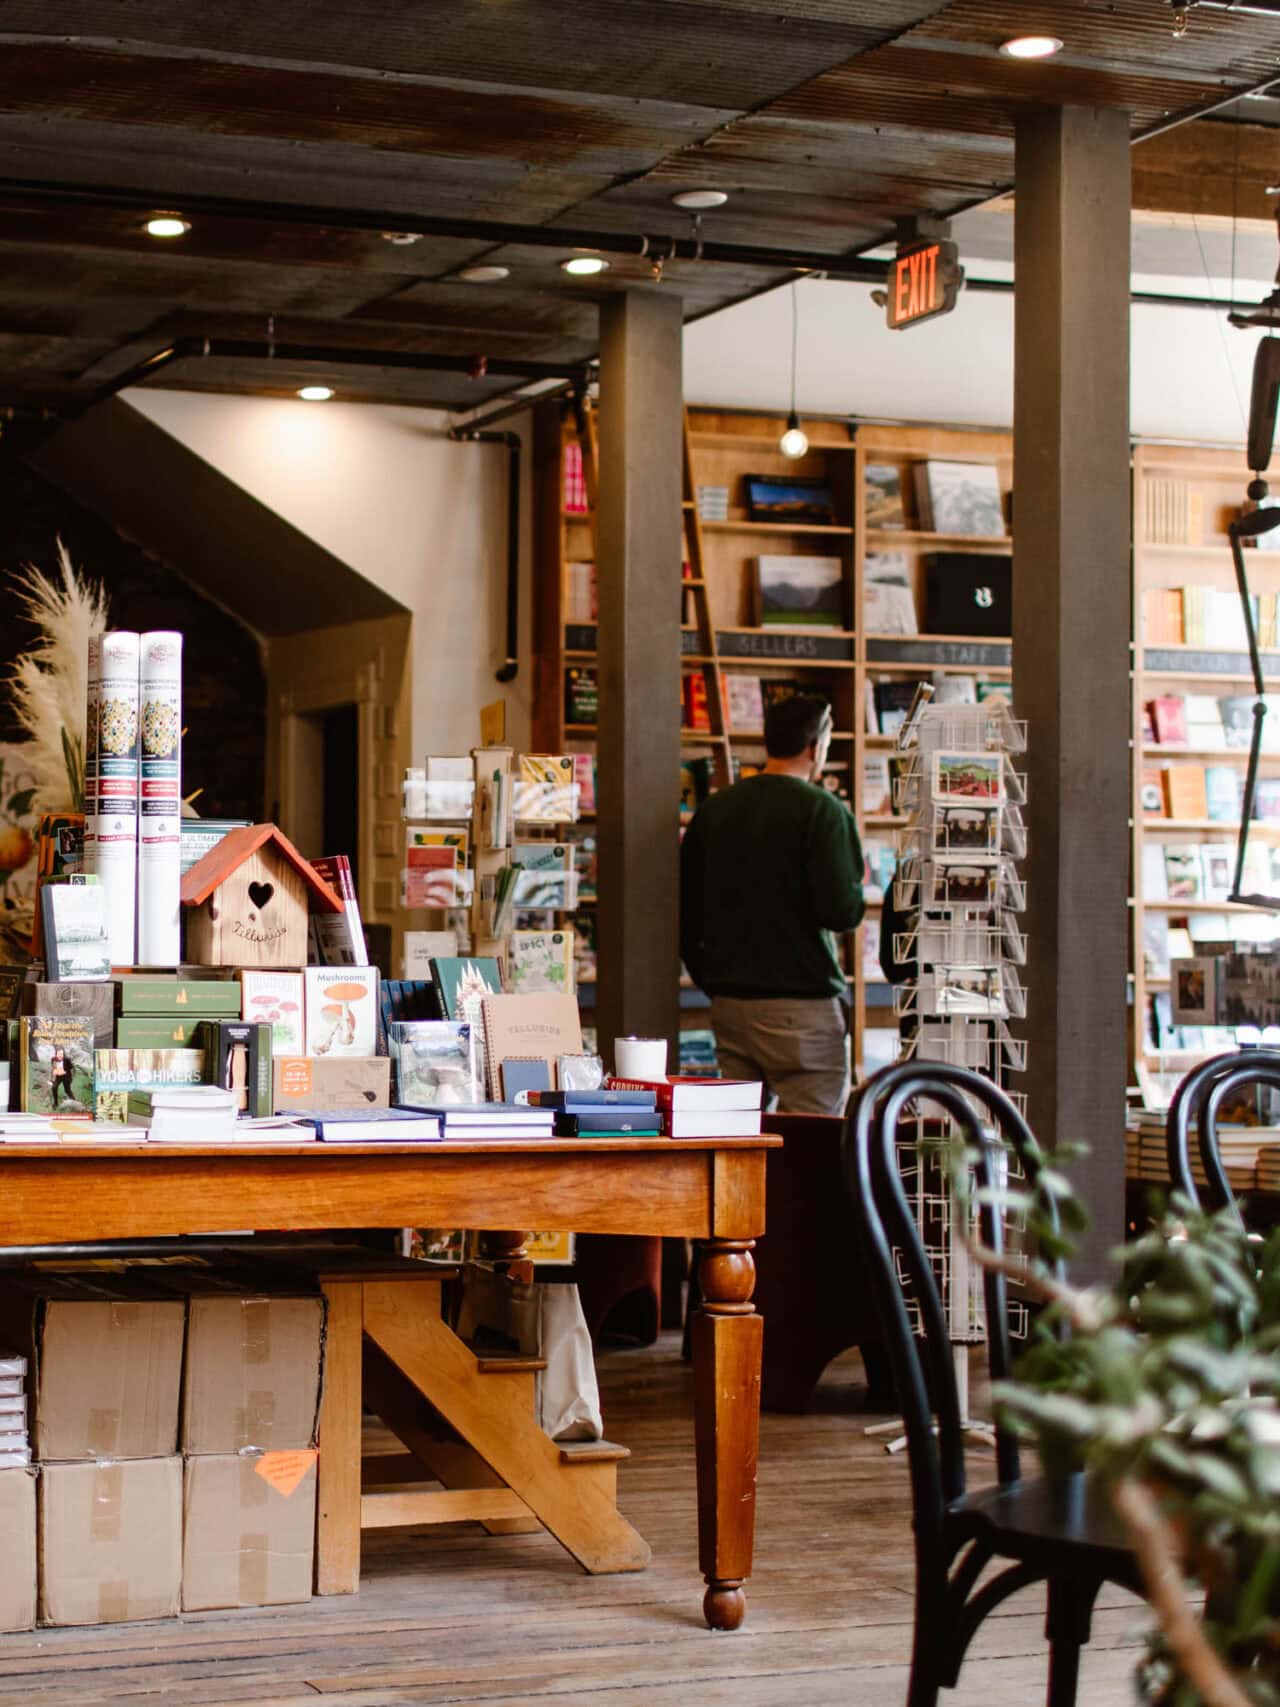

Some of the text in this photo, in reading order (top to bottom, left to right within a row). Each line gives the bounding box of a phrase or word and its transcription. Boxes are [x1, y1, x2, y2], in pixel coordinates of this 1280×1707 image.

[895, 245, 940, 322] EXIT
[739, 636, 818, 657] SELLERS
[317, 974, 366, 982] Mushrooms
[101, 1070, 136, 1081] YOGA
[154, 1071, 201, 1081] HIKERS
